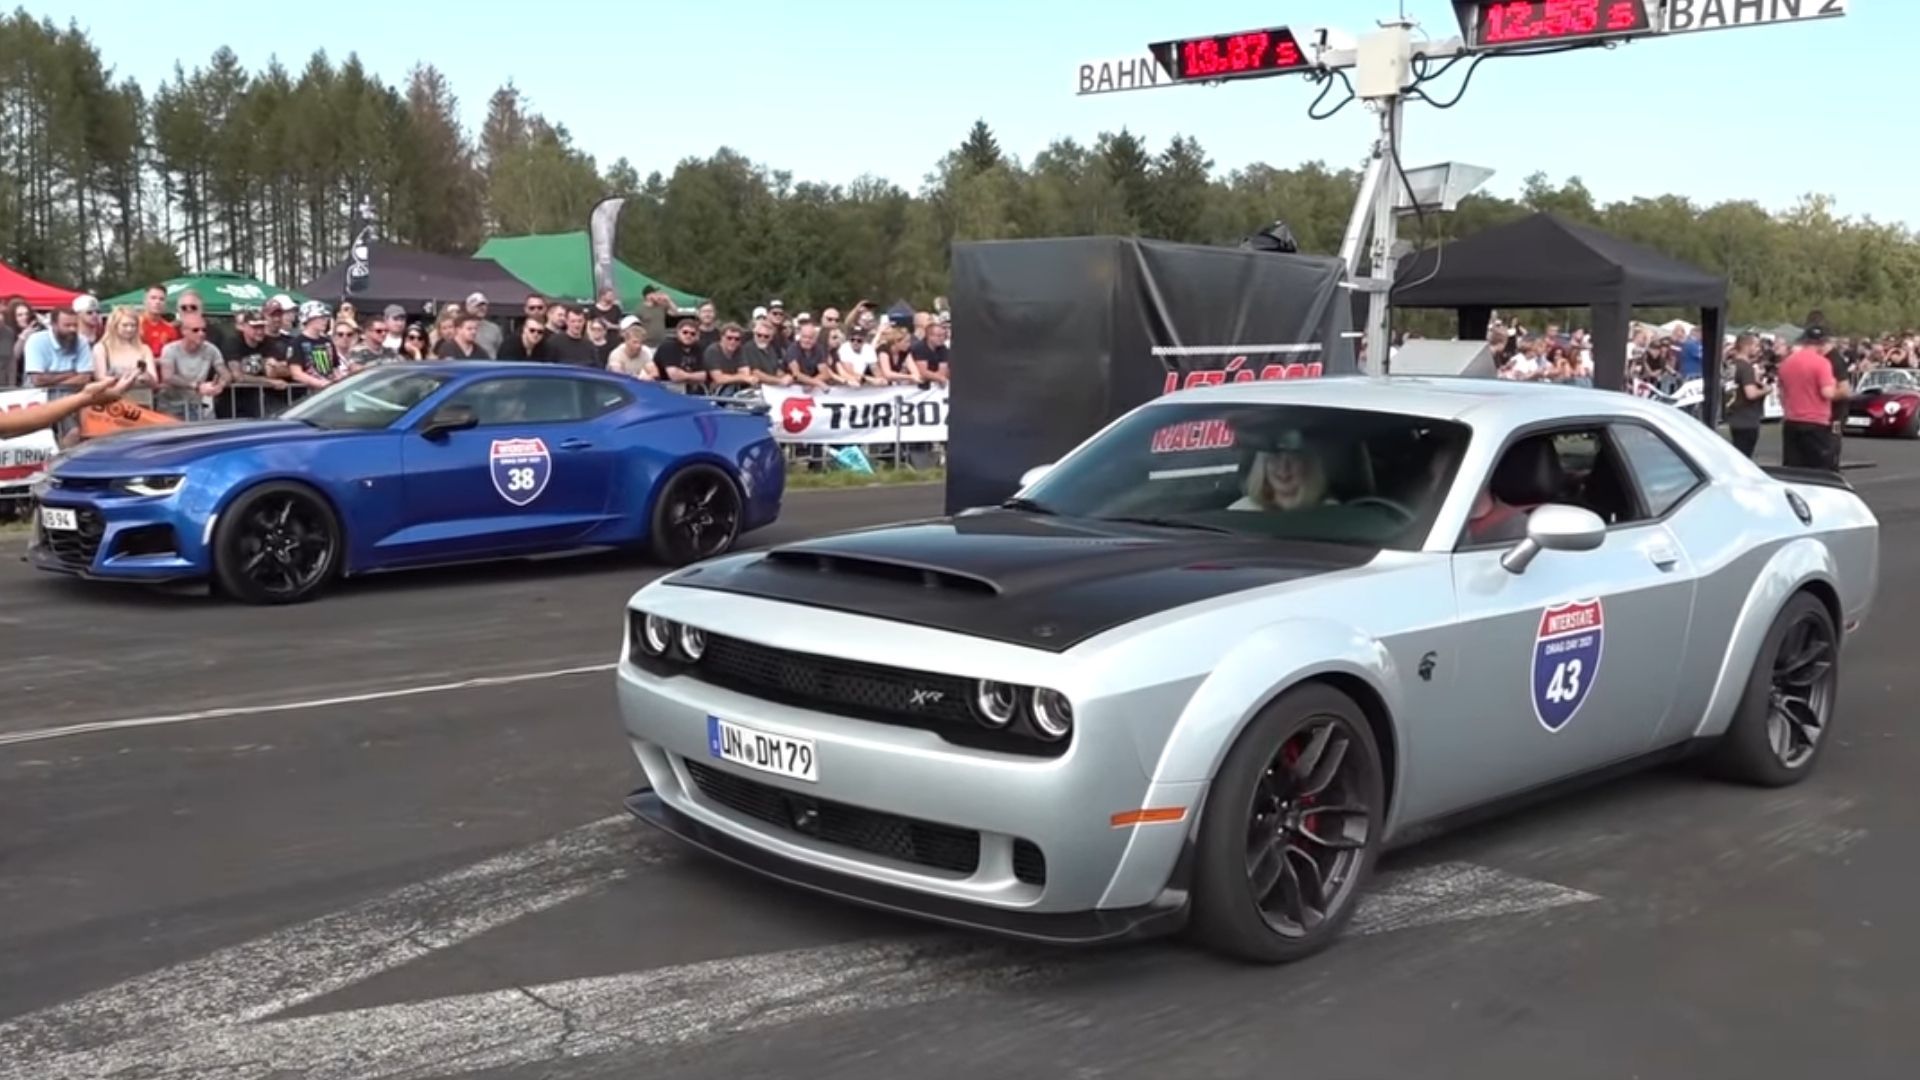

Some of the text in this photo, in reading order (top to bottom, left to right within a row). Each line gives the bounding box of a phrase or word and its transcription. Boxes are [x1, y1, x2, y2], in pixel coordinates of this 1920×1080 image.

[1487, 0, 1599, 41] 12.53
[1669, 0, 1800, 31] BAHN
[1079, 58, 1157, 92] BAHN
[822, 400, 949, 429] TURBO
[508, 467, 535, 490] 38
[1548, 607, 1595, 633] INTERSTATE
[1545, 659, 1582, 703] 43
[720, 725, 812, 775] UN DM 79
